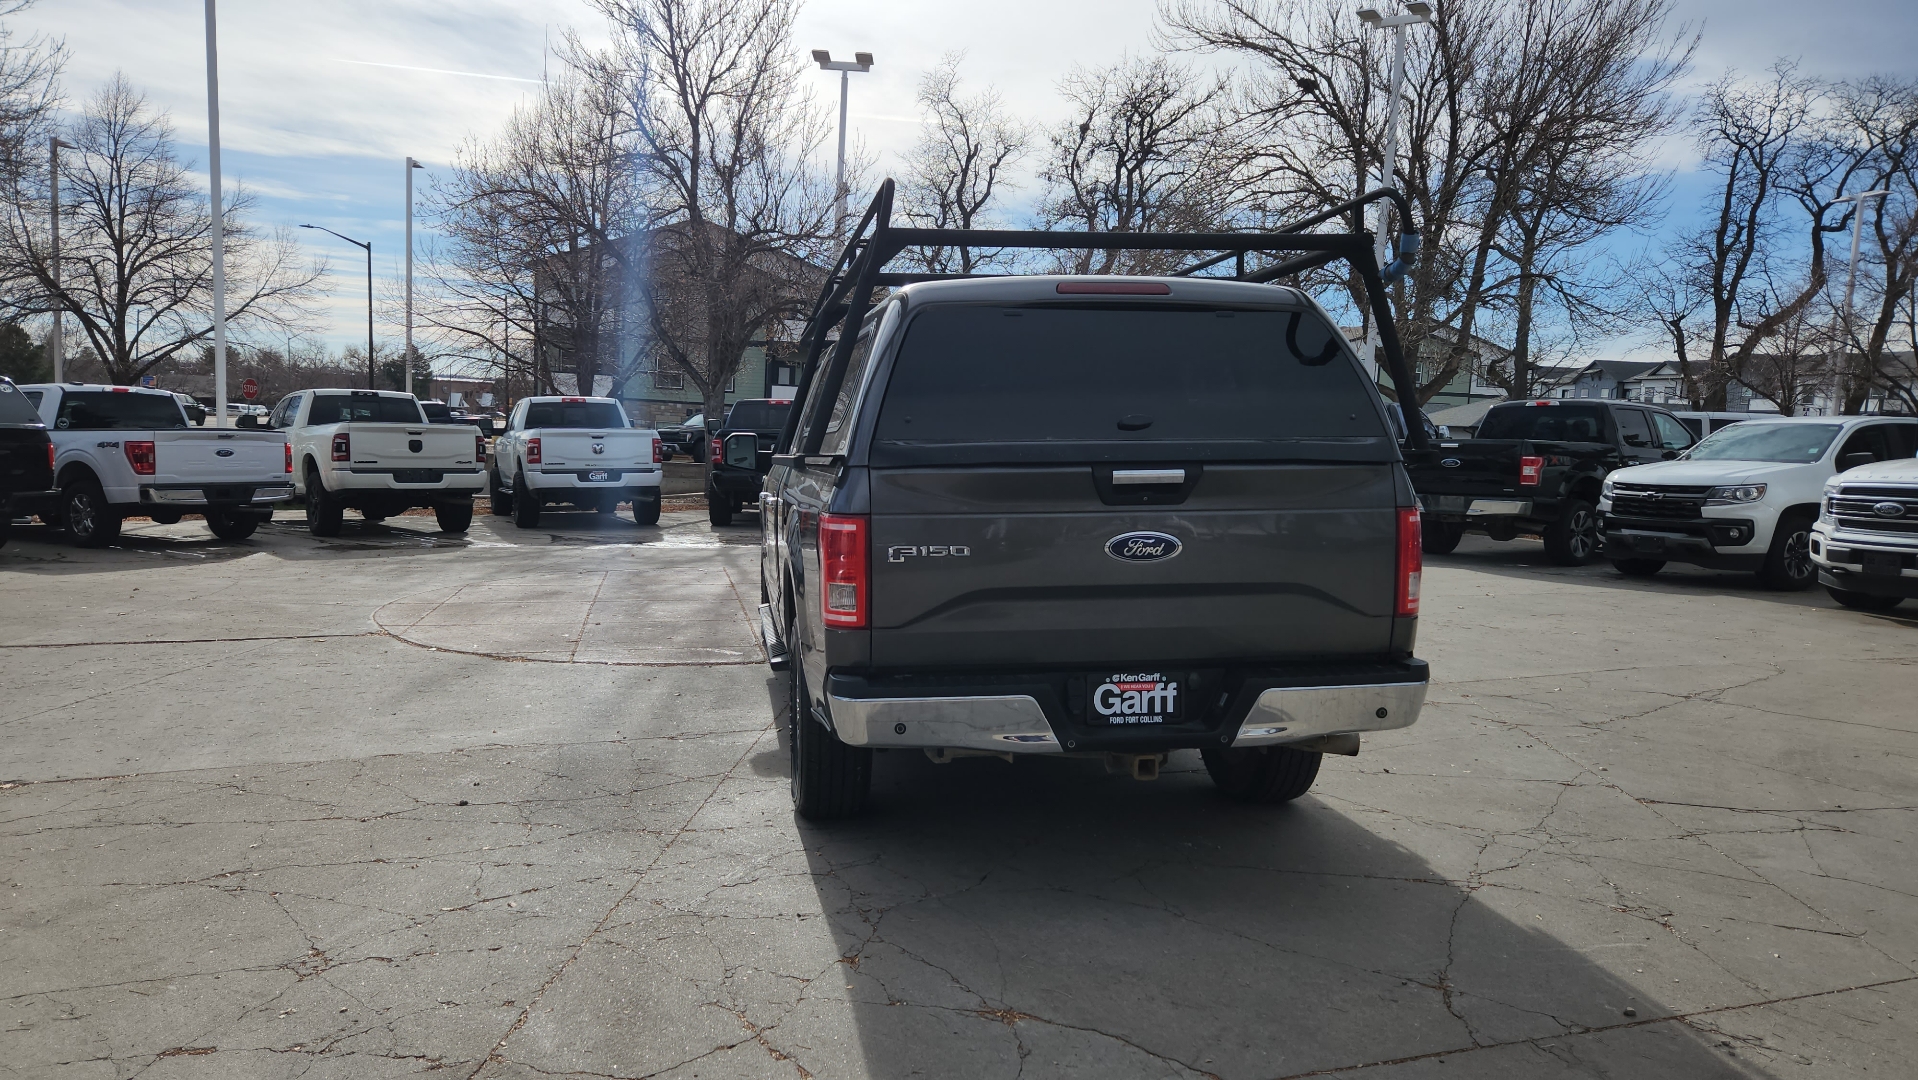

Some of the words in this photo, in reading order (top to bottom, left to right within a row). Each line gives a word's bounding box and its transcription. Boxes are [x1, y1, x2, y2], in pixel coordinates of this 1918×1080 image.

[243, 384, 257, 393] STOP
[588, 472, 608, 480] Garff
[1123, 538, 1166, 556] Ford
[1120, 673, 1138, 682] Ken
[1138, 672, 1161, 682] Garff
[1093, 682, 1178, 715] Garff
[1109, 716, 1125, 724] FORD
[1139, 715, 1163, 723] COLLINS
